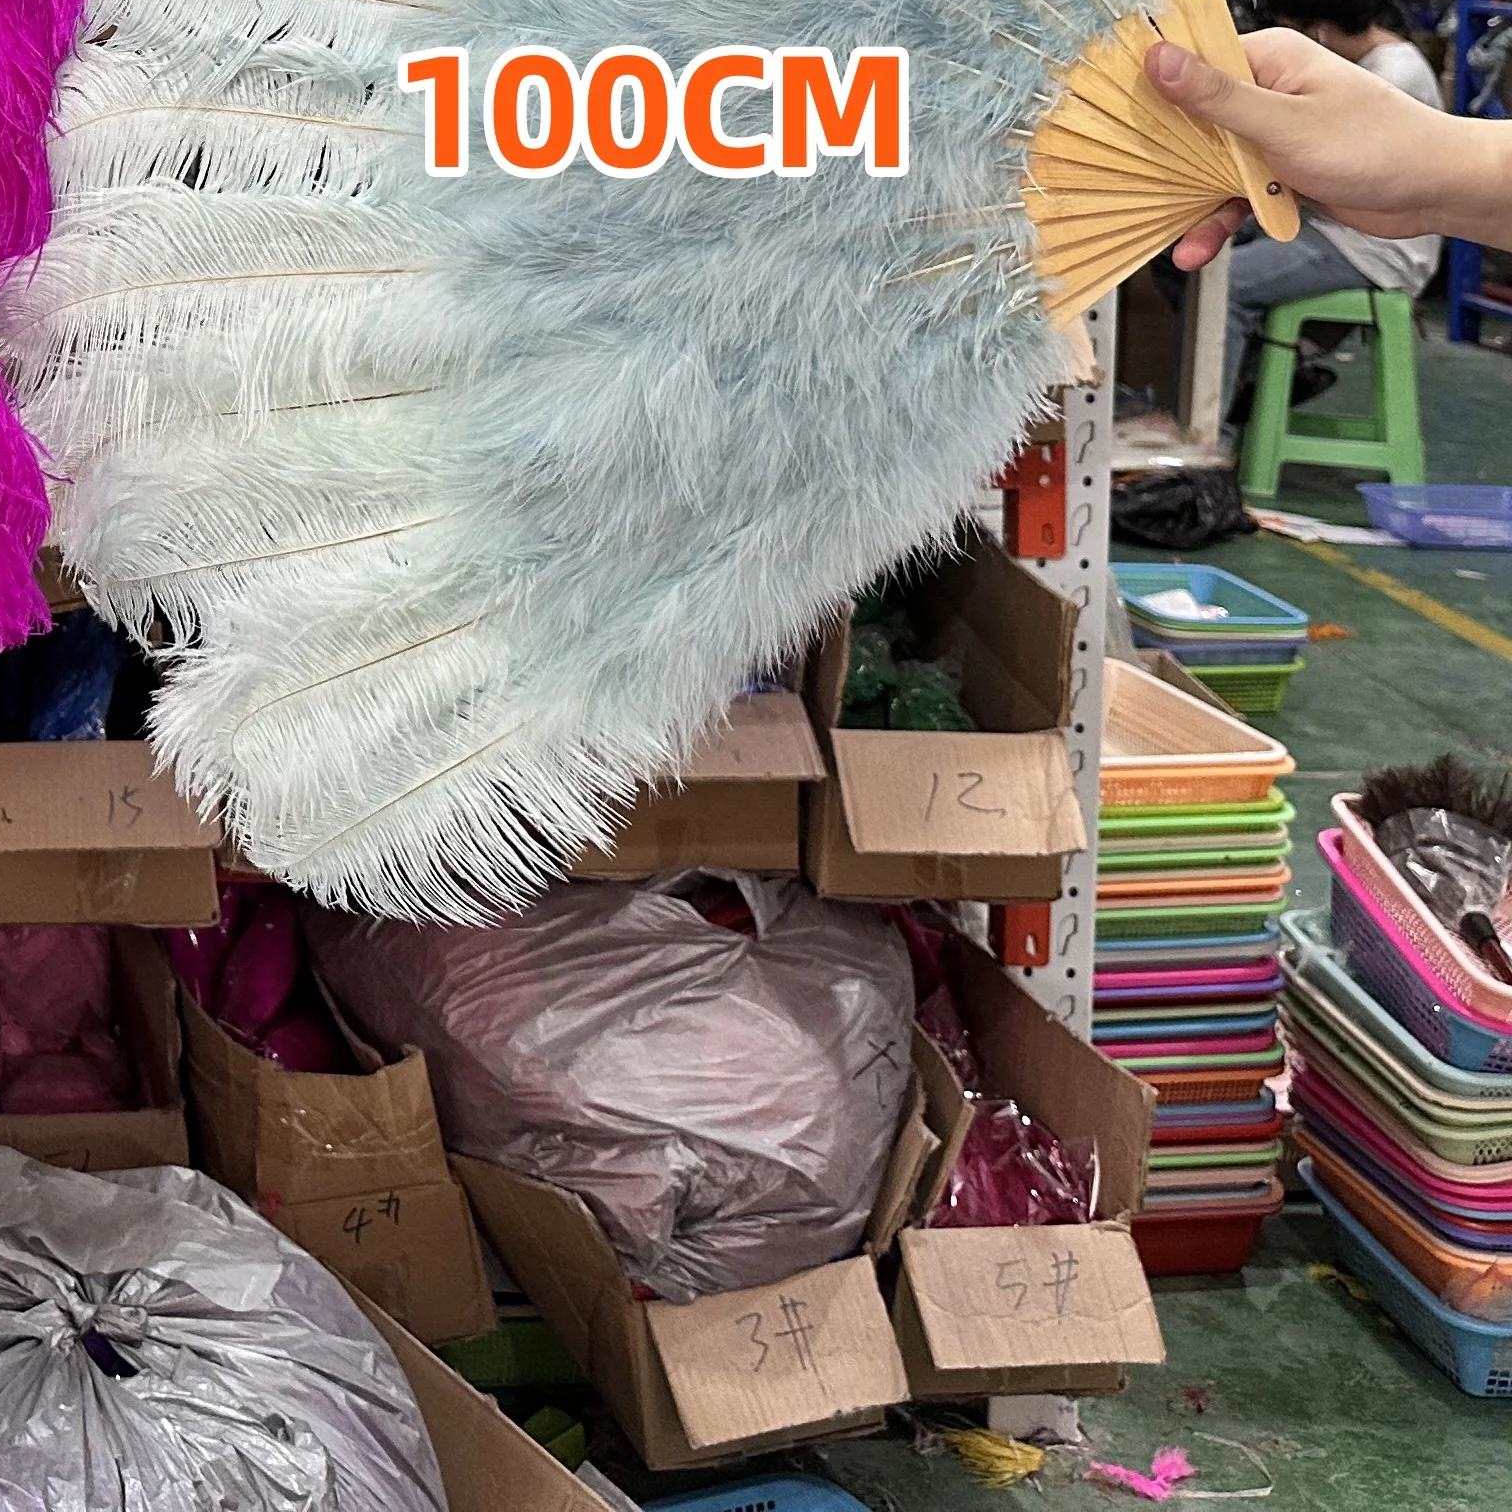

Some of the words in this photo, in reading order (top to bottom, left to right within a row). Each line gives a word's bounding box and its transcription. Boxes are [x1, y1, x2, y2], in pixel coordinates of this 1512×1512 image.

[106, 786, 144, 829] 15
[924, 771, 1006, 822] 12
[995, 1250, 1079, 1314] 5#
[734, 1294, 828, 1396] 3#
